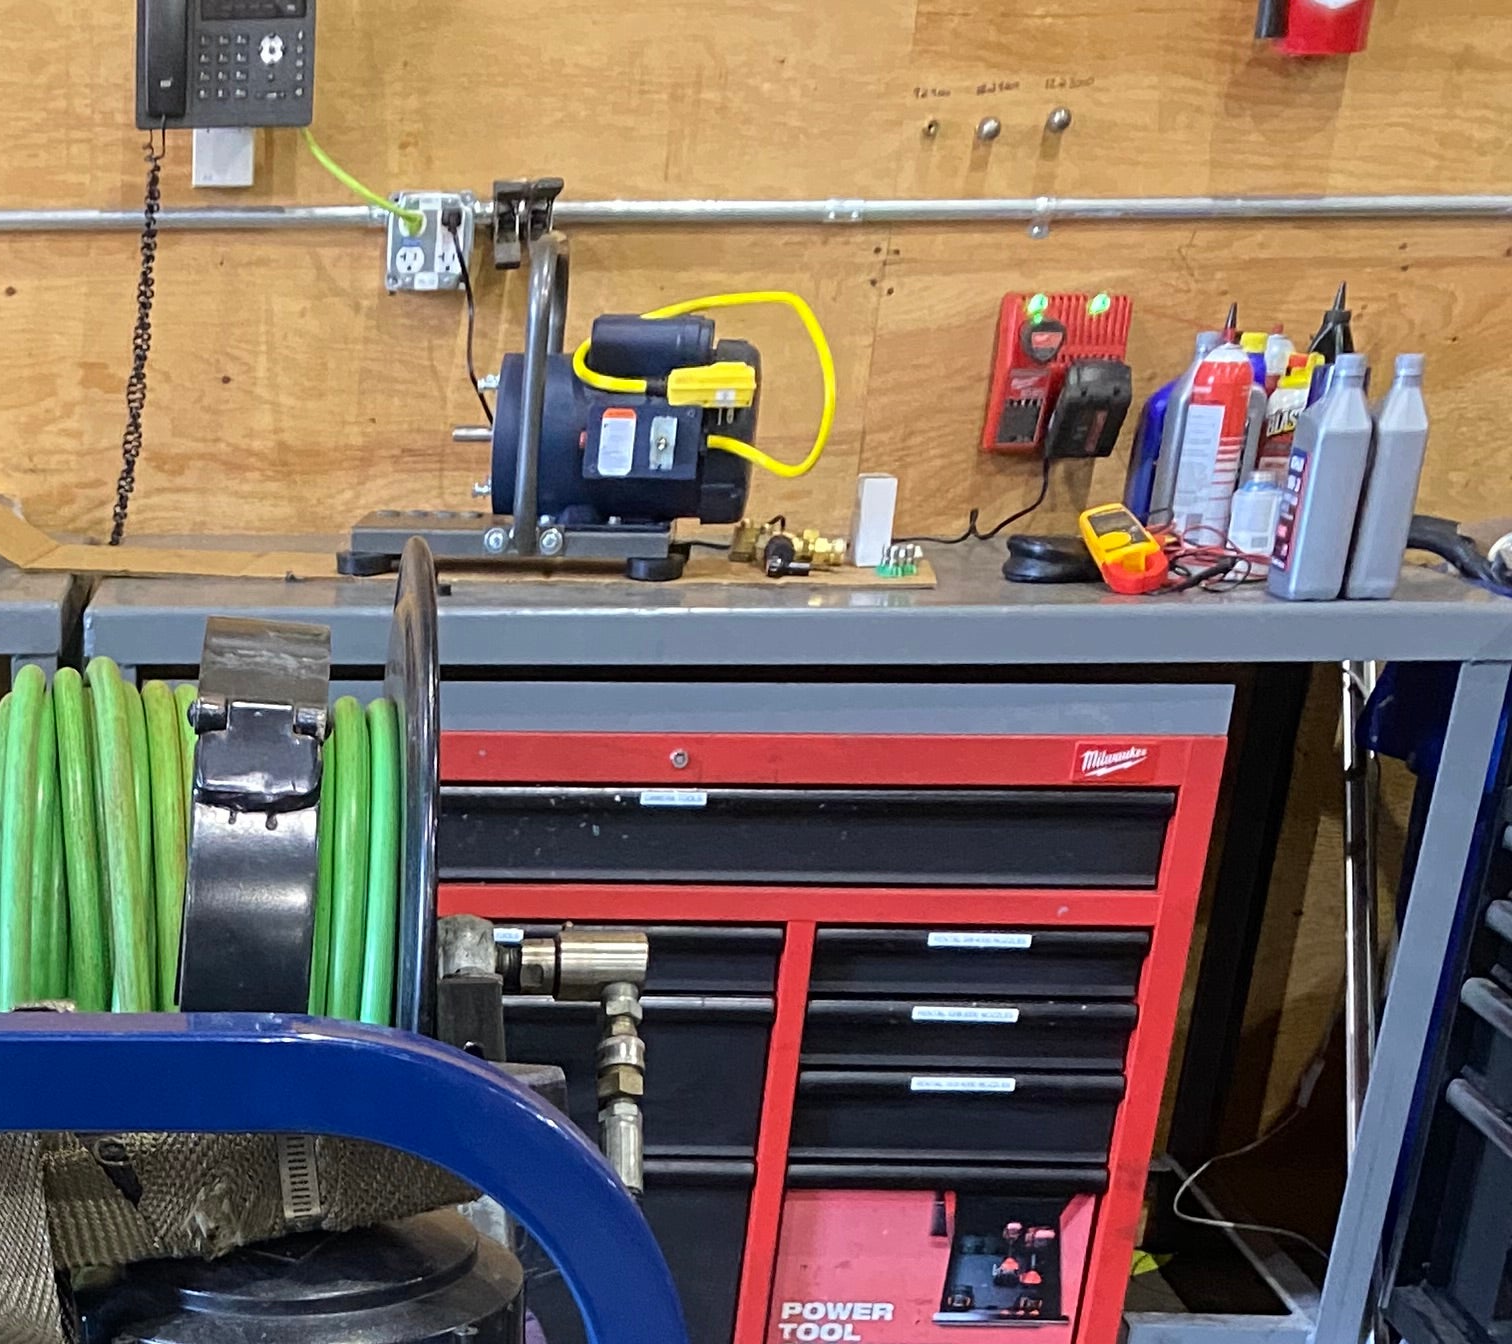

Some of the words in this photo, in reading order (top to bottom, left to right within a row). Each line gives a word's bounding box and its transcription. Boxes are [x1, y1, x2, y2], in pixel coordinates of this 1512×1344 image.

[1080, 746, 1148, 773] Milwaukee
[781, 1302, 895, 1321] POWER
[778, 1323, 862, 1341] TOOL
